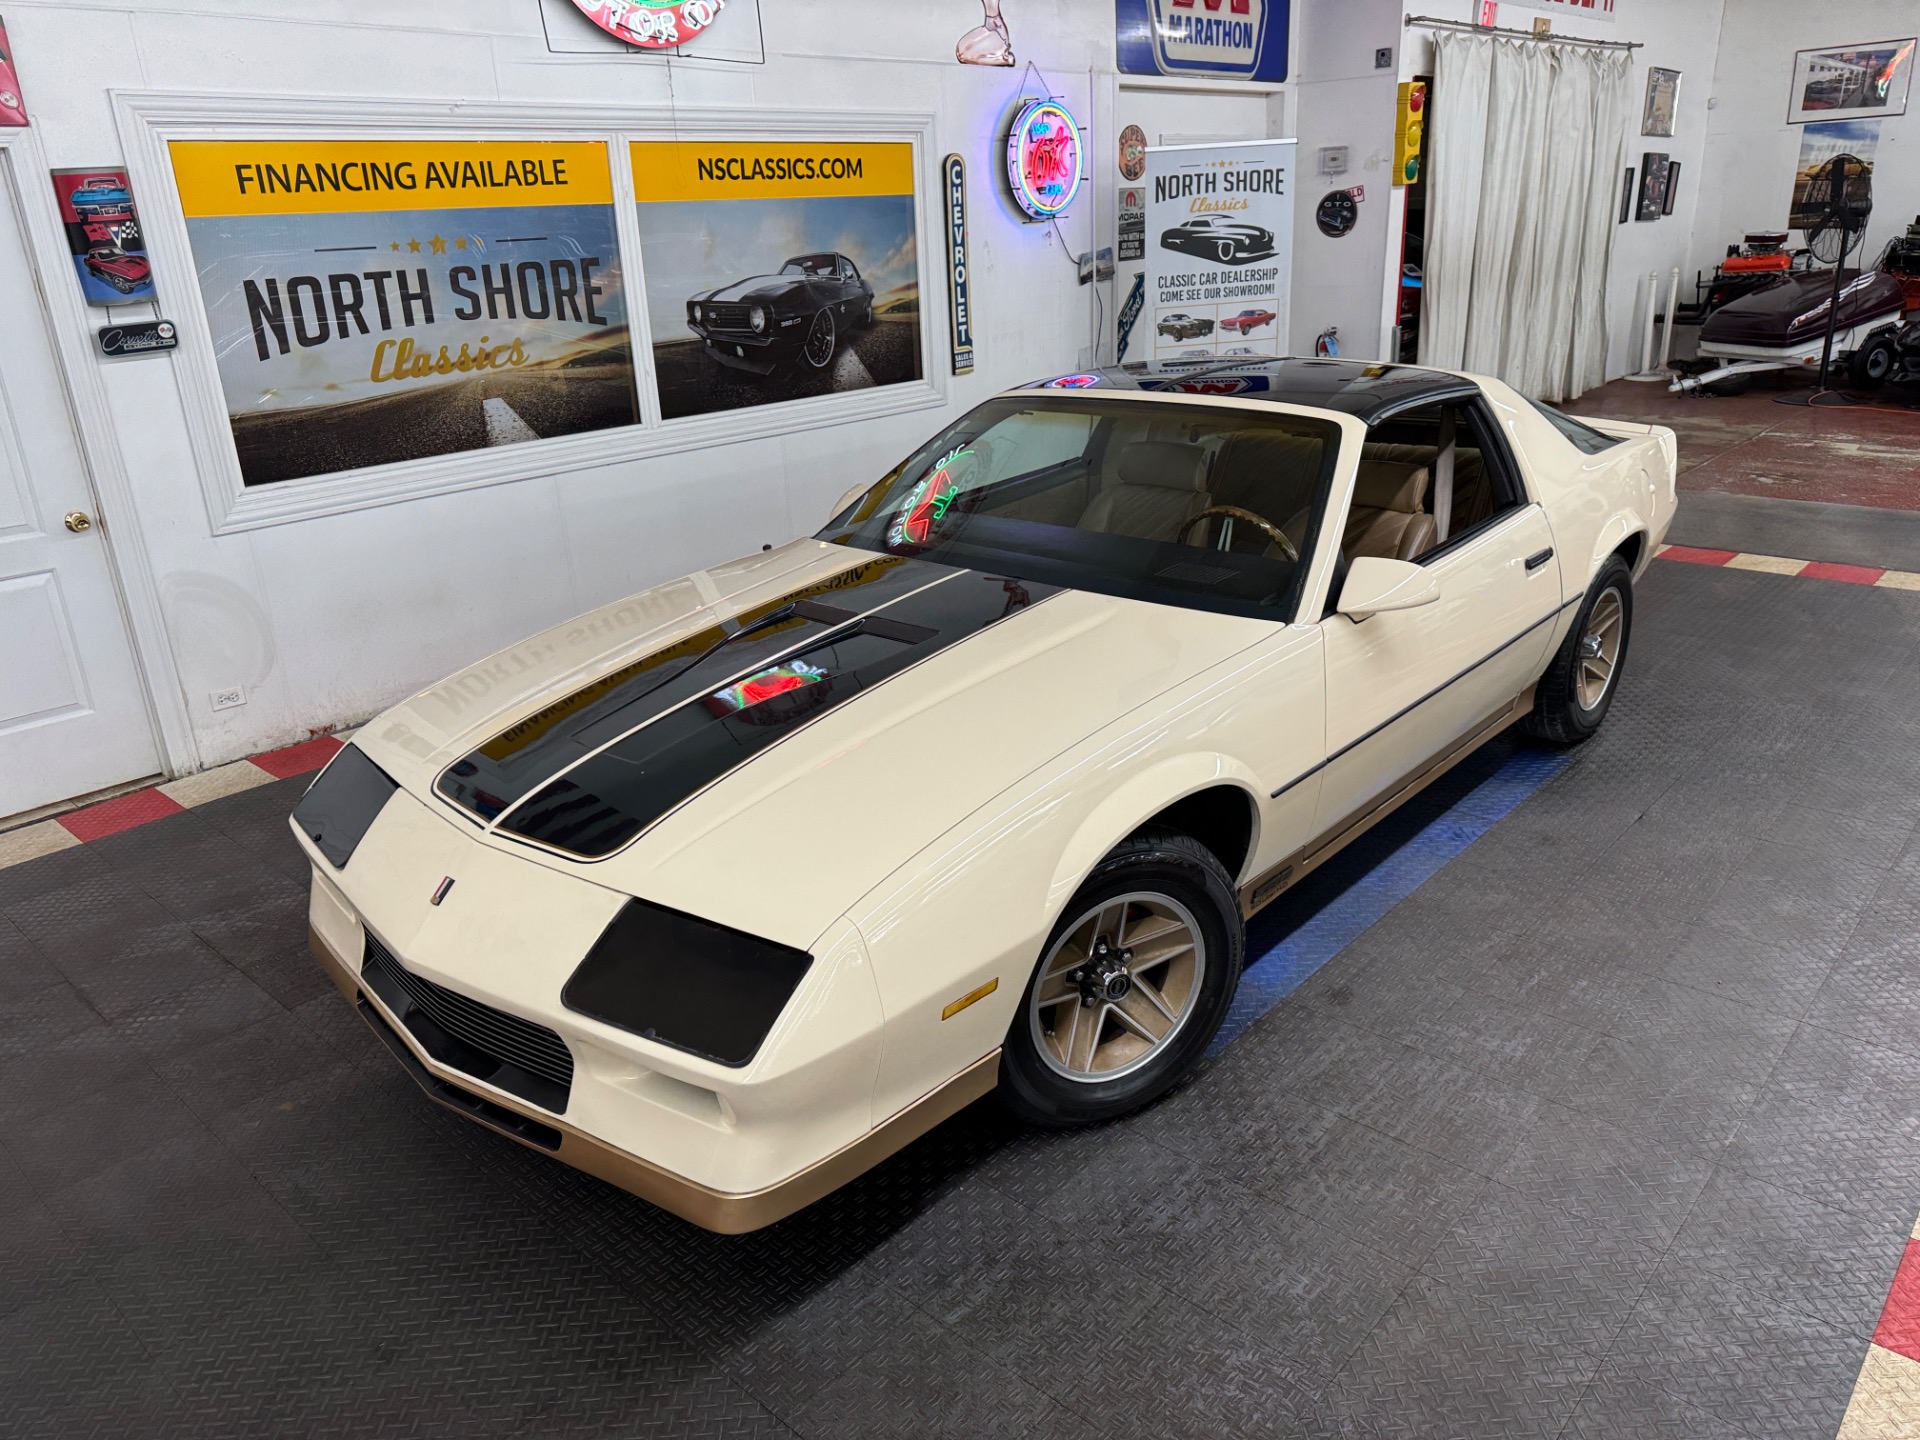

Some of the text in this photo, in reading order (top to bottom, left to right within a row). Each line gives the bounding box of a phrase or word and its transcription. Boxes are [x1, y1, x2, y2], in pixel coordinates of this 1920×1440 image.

[1168, 14, 1253, 49] MARATHON
[235, 159, 568, 195] FINANCING AVAILABLE
[697, 158, 863, 181] NSCLASSICS.COM
[1155, 168, 1284, 203] NORTH SHORE
[1118, 212, 1145, 221] MOPAR
[1189, 197, 1249, 213] Classics
[951, 165, 968, 343] CHEVROLET
[1158, 267, 1279, 288] CLASSIC CAR DEALERSHIP
[1160, 289, 1185, 303] COME
[1186, 288, 1202, 300] SEE
[1204, 286, 1221, 299] OUR
[1223, 282, 1275, 297] SHOWROOM!
[243, 257, 608, 361] NORTH SHORE
[103, 329, 161, 352] Corvette
[370, 336, 529, 383] Classics
